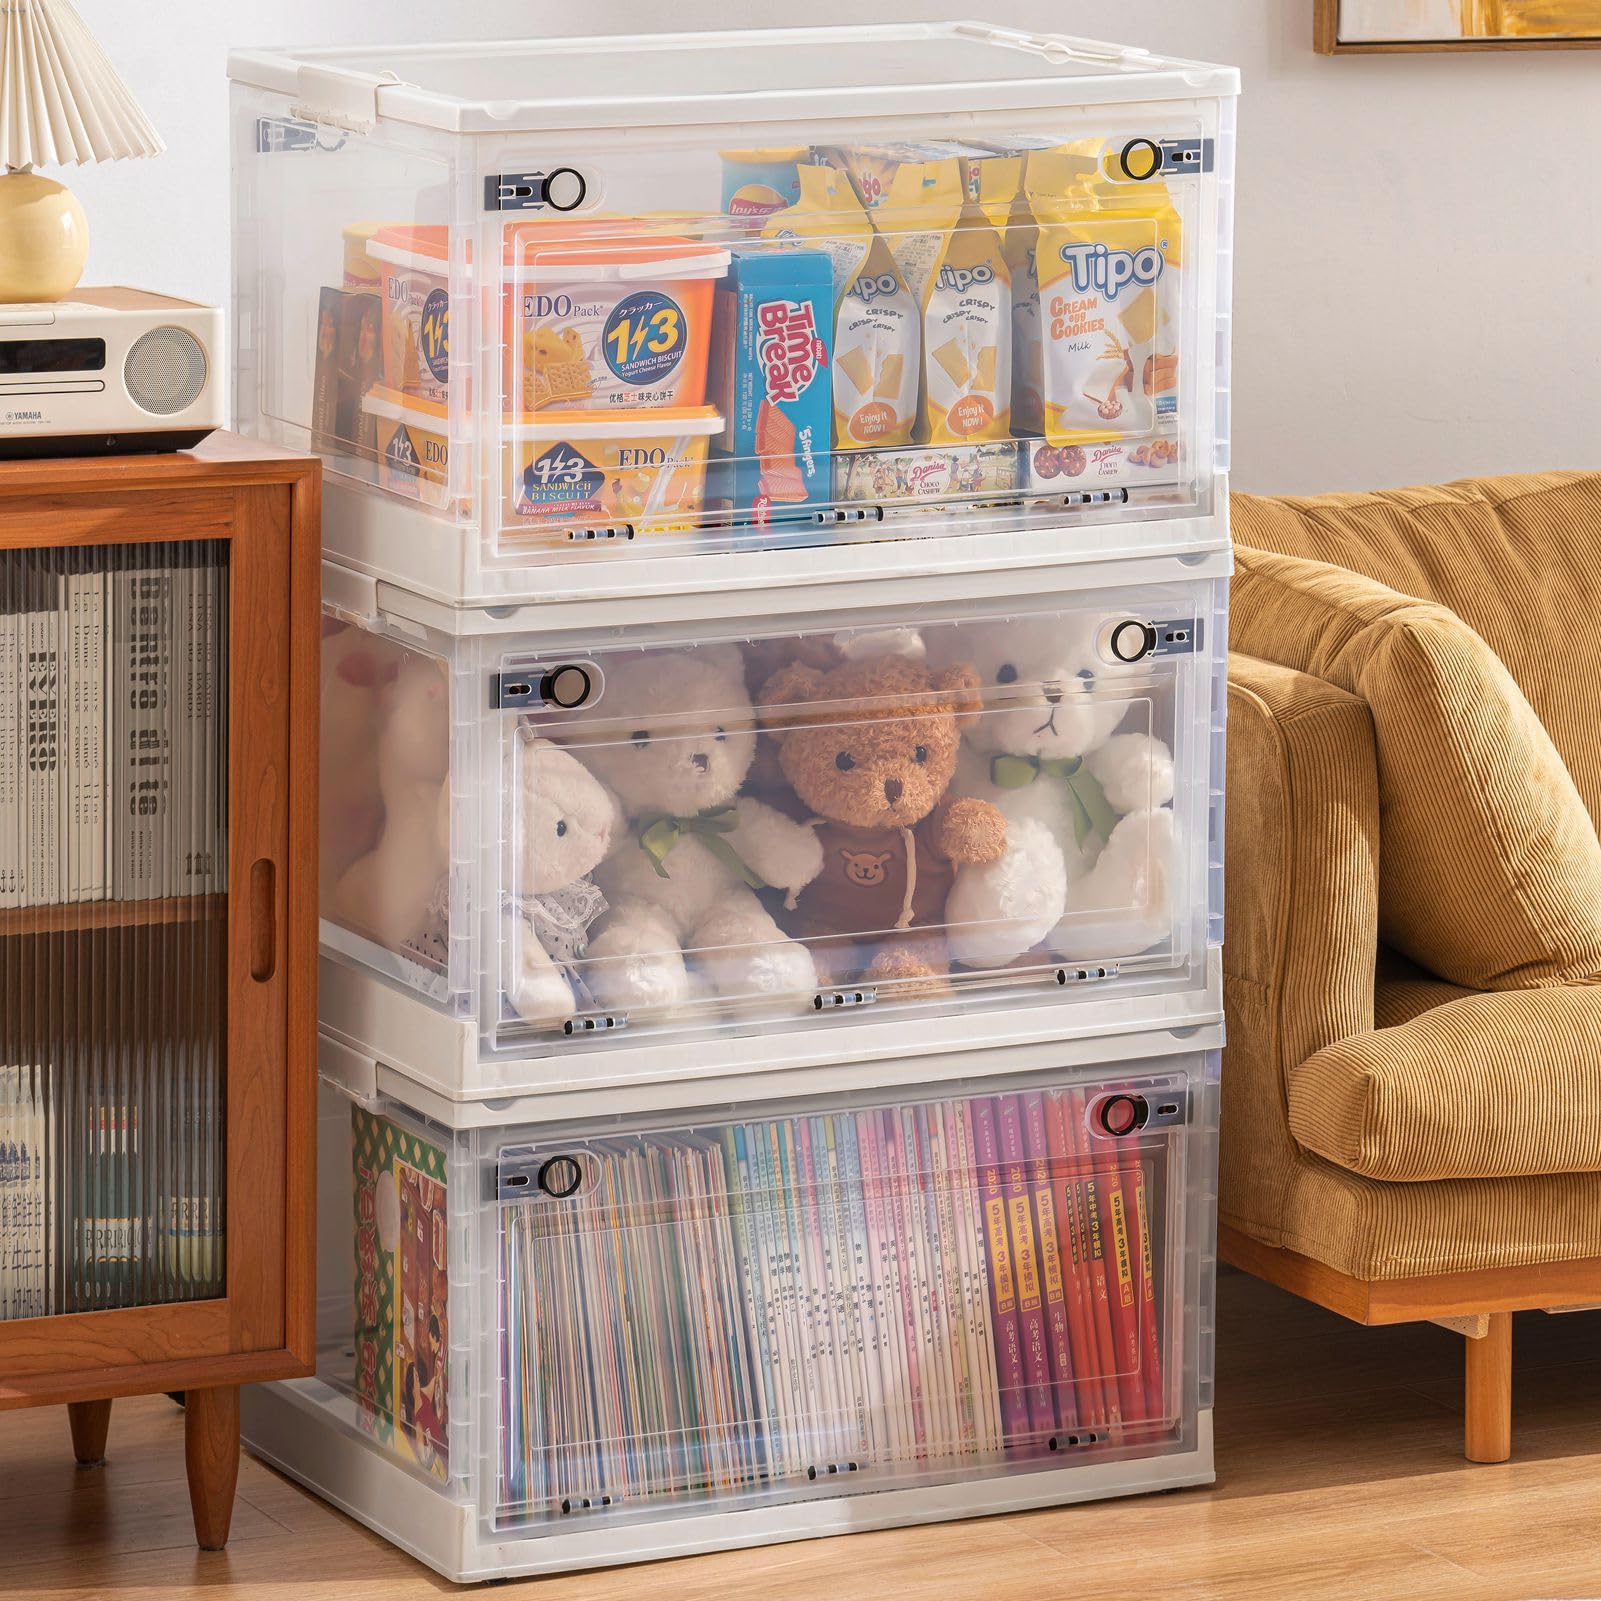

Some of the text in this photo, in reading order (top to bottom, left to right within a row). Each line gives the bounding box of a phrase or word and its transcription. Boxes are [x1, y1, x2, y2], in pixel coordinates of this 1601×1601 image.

[1060, 242, 1166, 301] Tipo
[388, 277, 408, 302] EDO
[520, 294, 600, 318] EDO Pack
[1069, 312, 1086, 323] egg
[1050, 318, 1105, 341] COOKIES
[761, 303, 798, 403] Break
[787, 304, 814, 385] Time
[1068, 341, 1092, 352] Milk
[621, 350, 683, 372] SANDWICH BISCUIT
[621, 361, 672, 379] Yogurt Cheese Flavor
[14, 411, 42, 420] YAMAHA
[860, 413, 880, 424] Enjoy
[958, 406, 977, 417] Enjoy
[425, 440, 448, 465] EDO
[618, 448, 665, 471] EDO
[910, 462, 946, 481] Danisa
[532, 481, 592, 492] SANDWICH
[532, 491, 590, 500] BISCUIT
[522, 503, 595, 515] BANANA MILK FLAVOR
